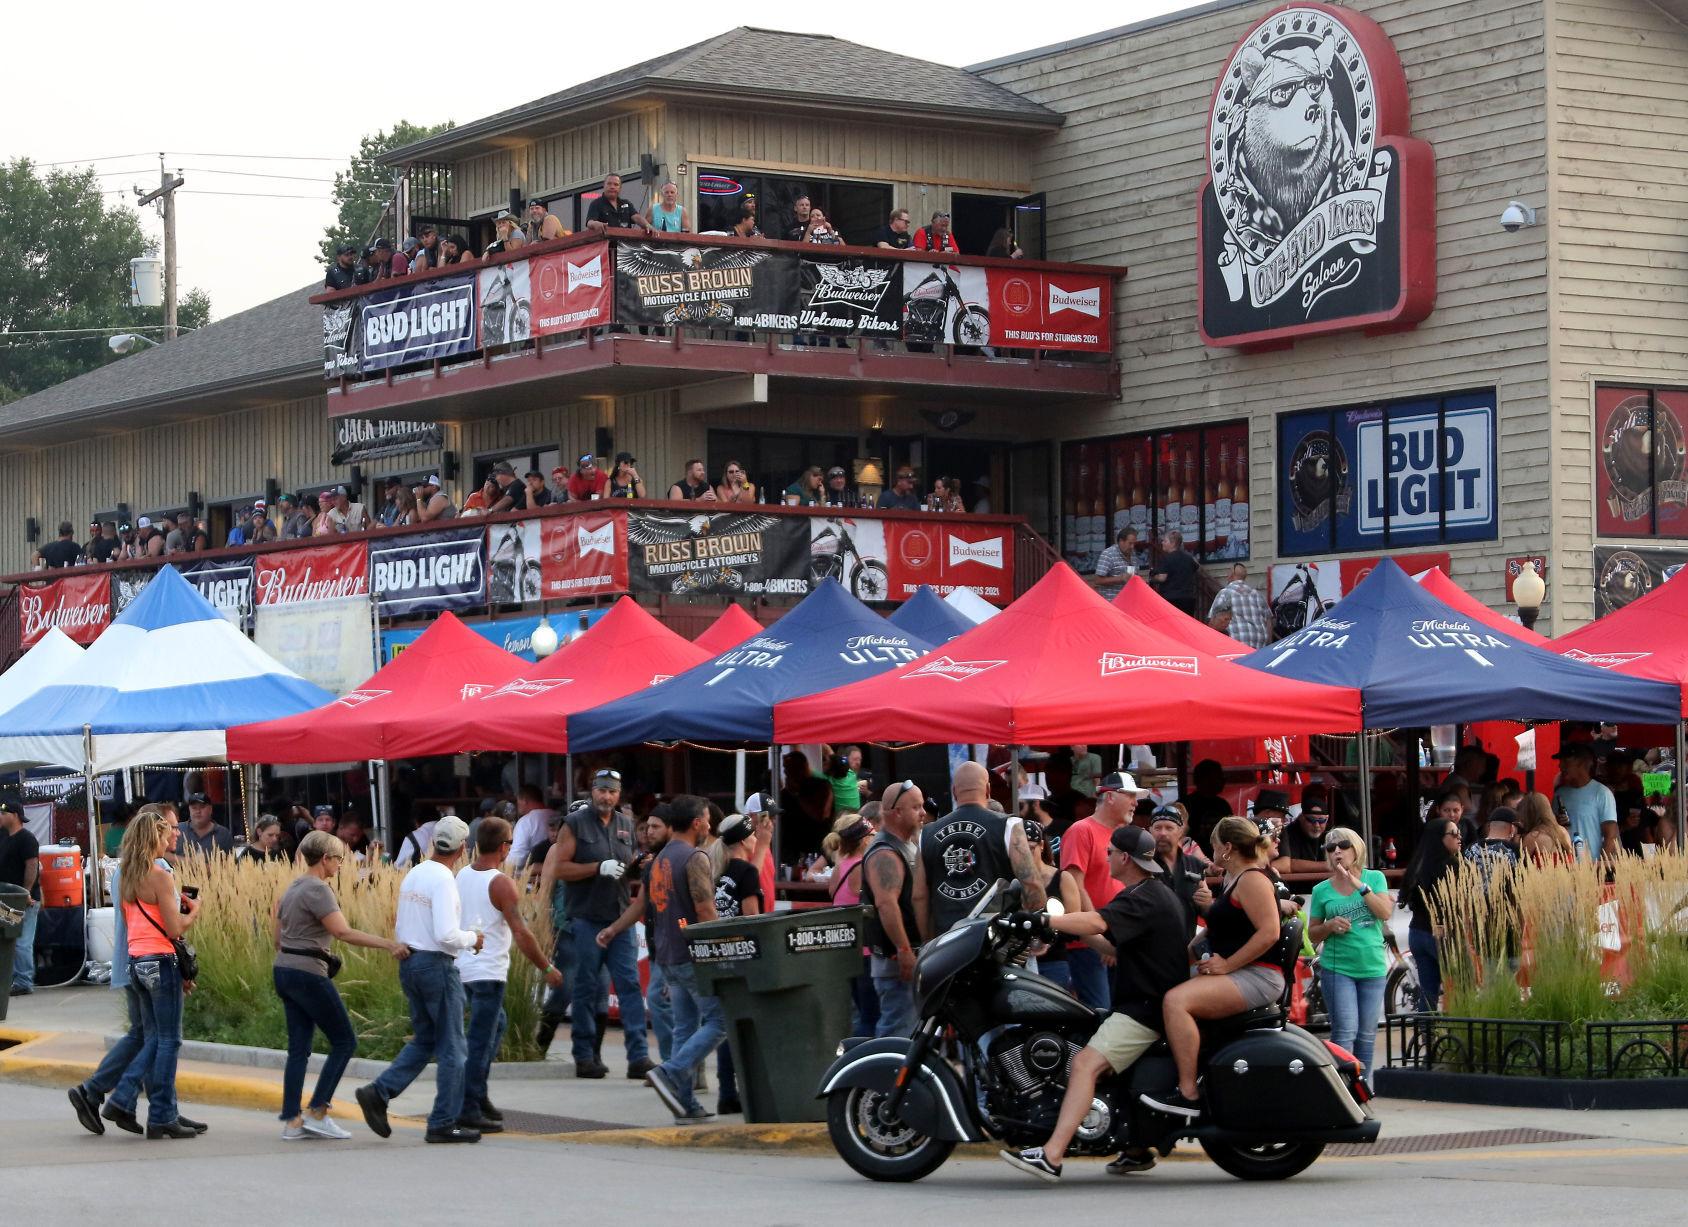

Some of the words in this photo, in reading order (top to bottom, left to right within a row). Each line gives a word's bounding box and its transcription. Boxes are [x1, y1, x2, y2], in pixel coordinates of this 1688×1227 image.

[1254, 213, 1326, 304] ONE-EYED
[637, 272, 683, 296] RUSS
[688, 267, 752, 291] BROWN
[1302, 257, 1346, 308] Saloon
[643, 292, 700, 306] MOTORCYCLE
[700, 288, 750, 301] ATTORNEYS
[815, 283, 883, 302] Budweiser
[1052, 294, 1098, 307] Budweiser
[366, 311, 409, 346] BUD
[410, 298, 469, 338] LIGHT
[734, 312, 798, 329] 1-800-4BIKERS
[800, 310, 854, 328] Welcome
[858, 316, 899, 331] Bikers
[1004, 329, 1020, 340] THIS
[1020, 331, 1040, 341] BUD'S
[1041, 332, 1053, 342] FOR
[1054, 333, 1082, 343] STURGIS
[1083, 334, 1098, 344] 2021
[1388, 426, 1465, 473] BUD
[1367, 468, 1481, 518] LIGHT
[644, 541, 692, 564] RUSS
[694, 532, 762, 559] BROWN
[952, 546, 1000, 558] Budweiser
[374, 559, 417, 592] BUD
[418, 551, 477, 588] LIGHT
[649, 560, 707, 575] MOTORCYCLE
[708, 553, 759, 567] ATTORNEYS
[258, 567, 365, 605] Budweiser
[743, 578, 808, 593] 1-800-4BIKERS
[902, 584, 917, 593] THIS
[940, 585, 954, 594] FOR
[985, 587, 1000, 596] 2021
[22, 595, 108, 635] Budweiser
[1411, 619, 1471, 632] Michelob
[846, 635, 908, 649] Michelob
[1407, 632, 1512, 649] ULTRA
[715, 650, 783, 668] ULTRA
[1098, 655, 1195, 669] Budweiser
[939, 823, 982, 838] TRIBE
[788, 928, 856, 946] 1-800-4-BIKERS
[688, 940, 757, 957] 1-800-4-BIKERS
